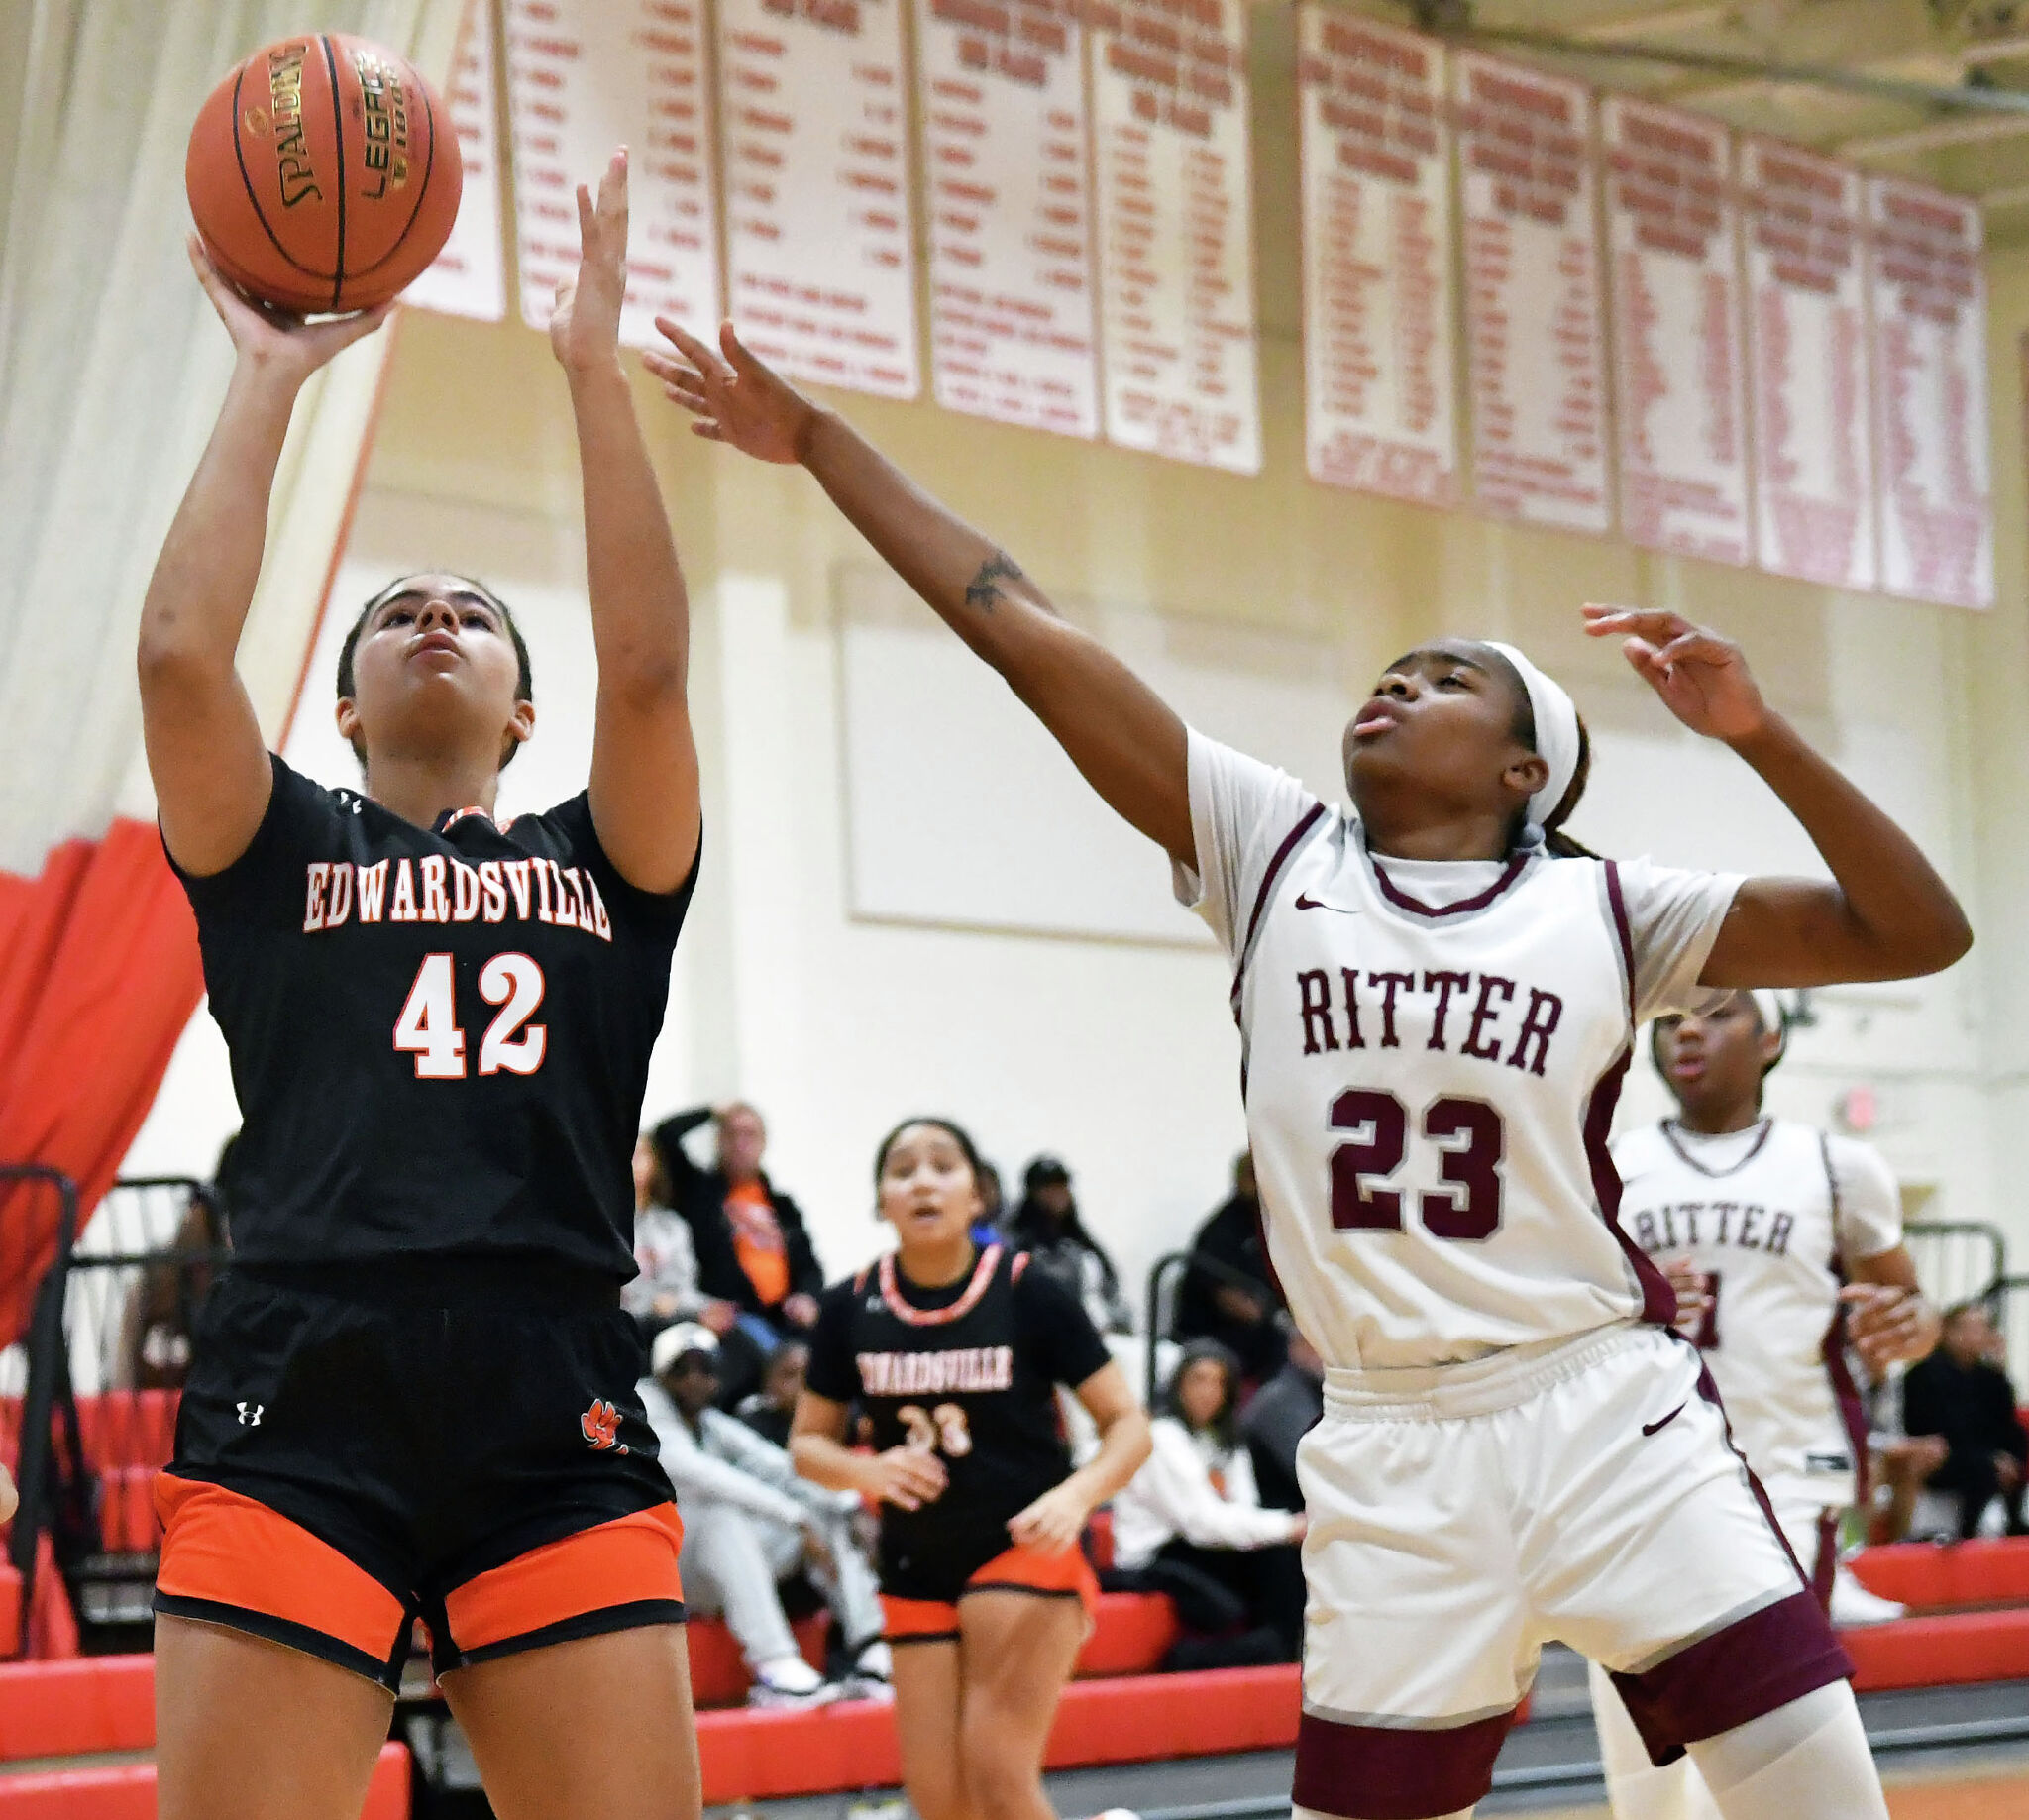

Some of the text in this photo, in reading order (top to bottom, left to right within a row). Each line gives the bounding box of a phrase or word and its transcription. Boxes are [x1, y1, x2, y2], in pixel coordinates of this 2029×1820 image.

[393, 951, 547, 1079] 42
[1297, 966, 1563, 1078] RITTER
[1326, 1085, 1506, 1245] 23
[1634, 1202, 1795, 1255] RITTER
